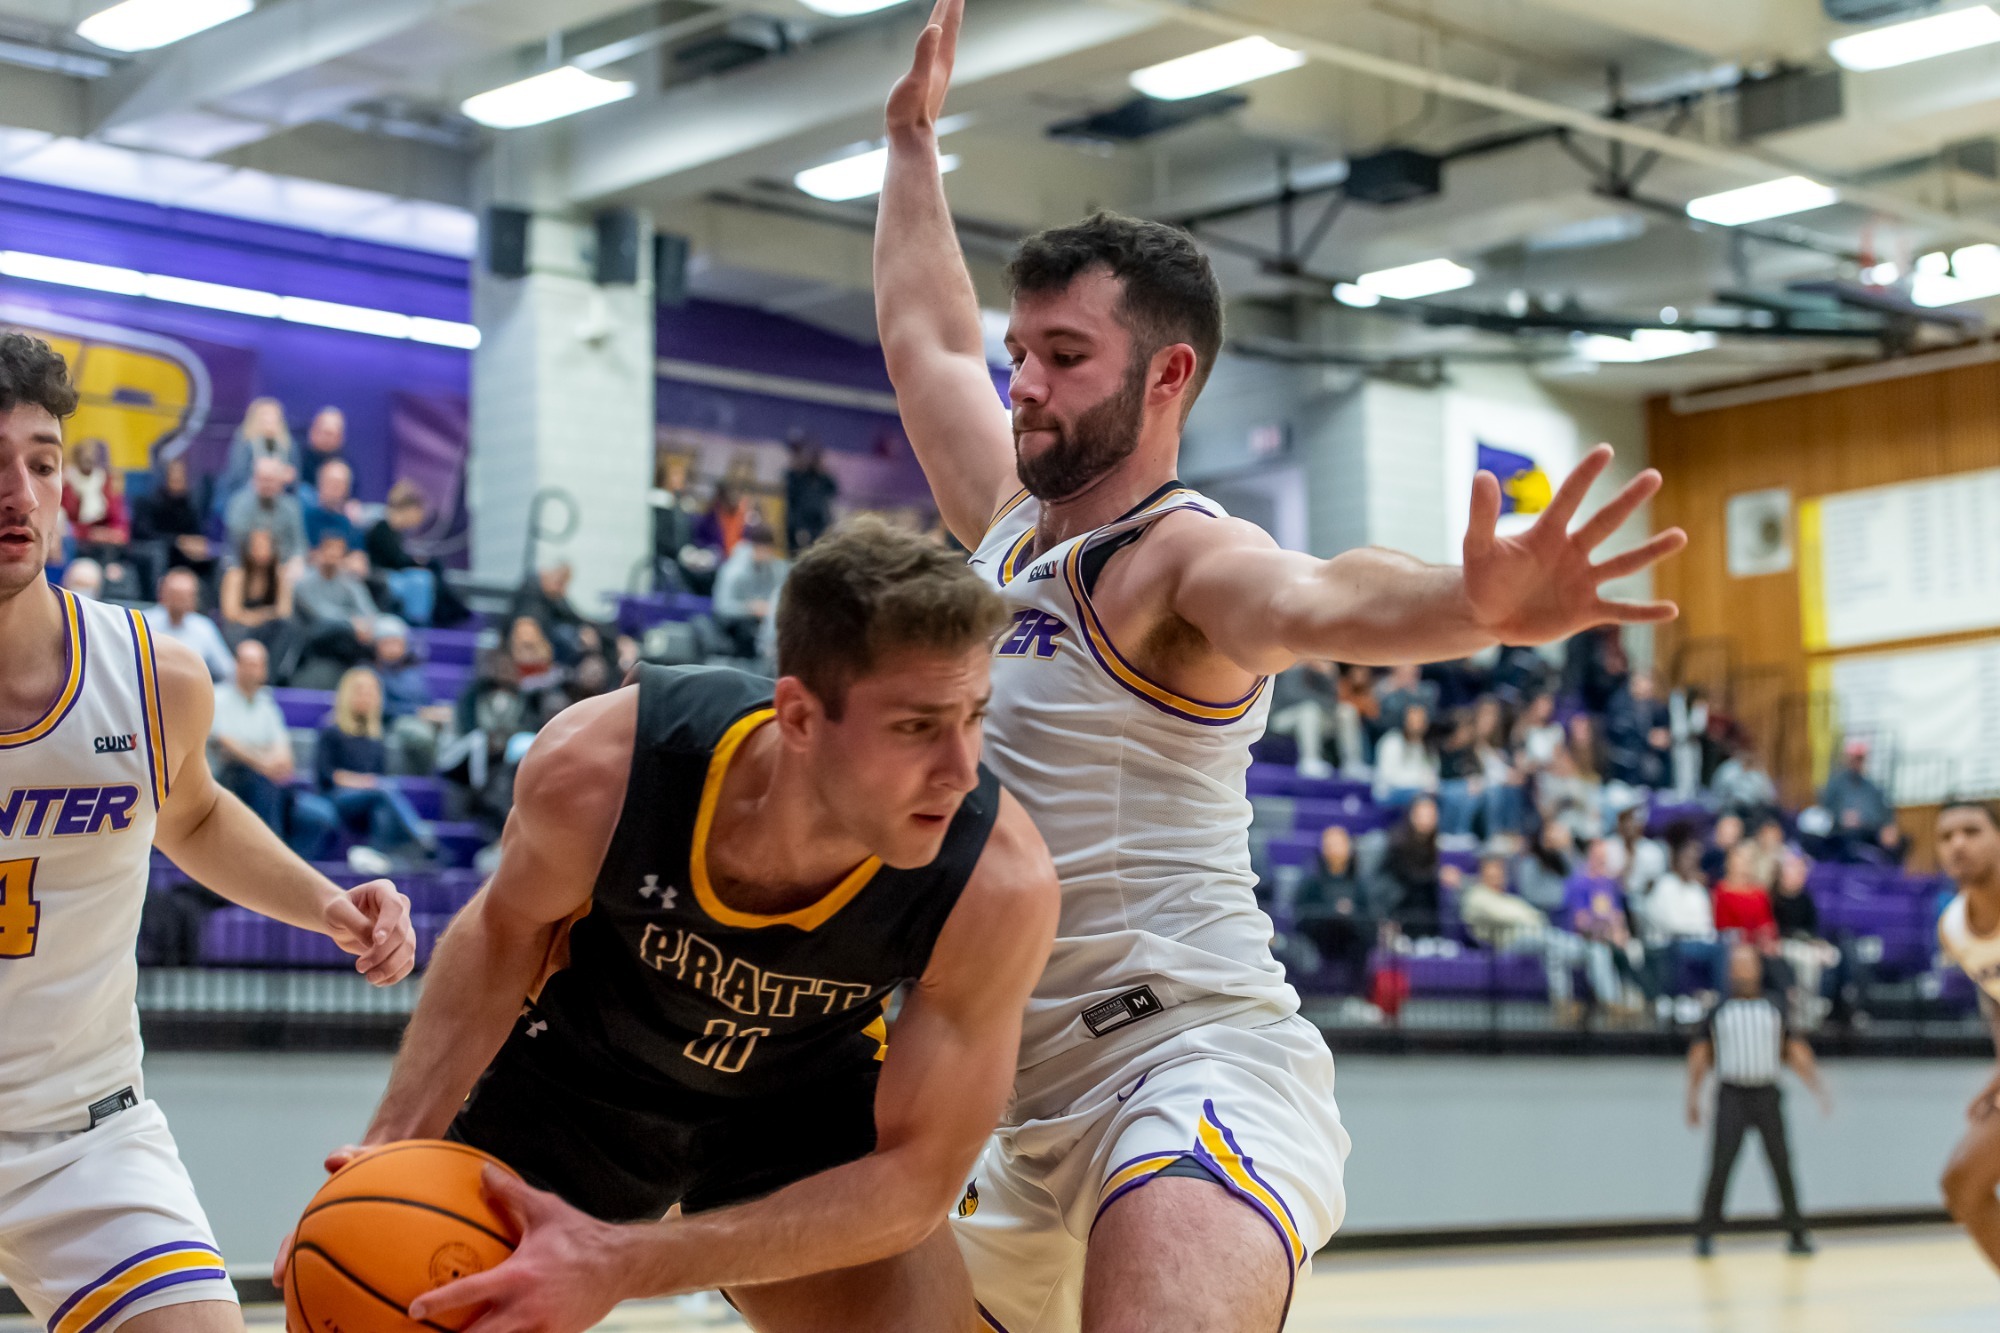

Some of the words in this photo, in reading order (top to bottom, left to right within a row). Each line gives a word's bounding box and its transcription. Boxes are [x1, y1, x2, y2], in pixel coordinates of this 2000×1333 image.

[1028, 560, 1058, 582] CUNY
[996, 608, 1069, 660] ER
[94, 733, 137, 753] CUNY
[640, 922, 872, 1017] PRATT
[1132, 995, 1149, 1009] M
[683, 1018, 770, 1073] 11
[123, 1096, 134, 1109] M
